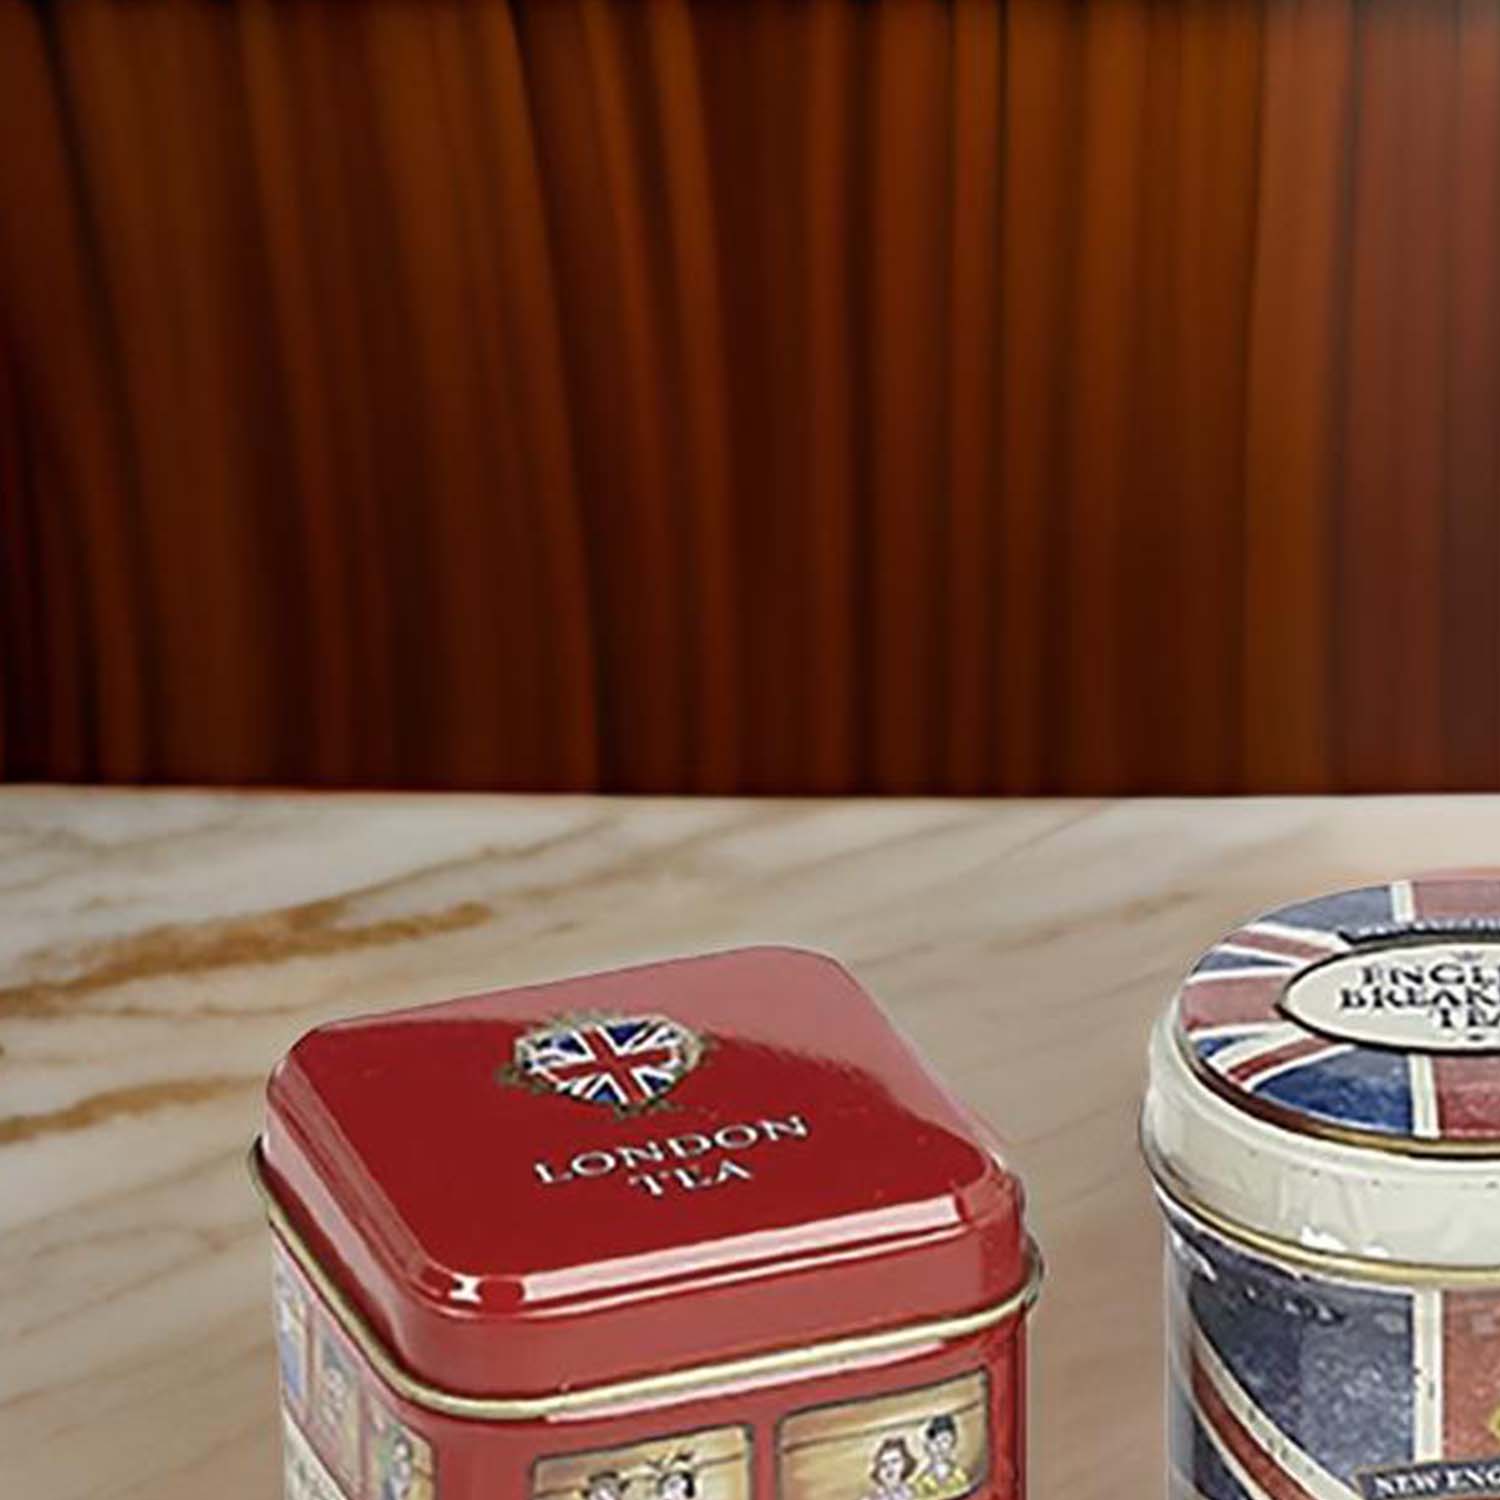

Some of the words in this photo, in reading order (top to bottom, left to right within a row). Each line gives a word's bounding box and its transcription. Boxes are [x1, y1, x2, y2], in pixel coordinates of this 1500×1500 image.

[534, 1114, 808, 1184] LONDON
[627, 1158, 752, 1196] TEA
[1373, 1472, 1441, 1497] NEW
